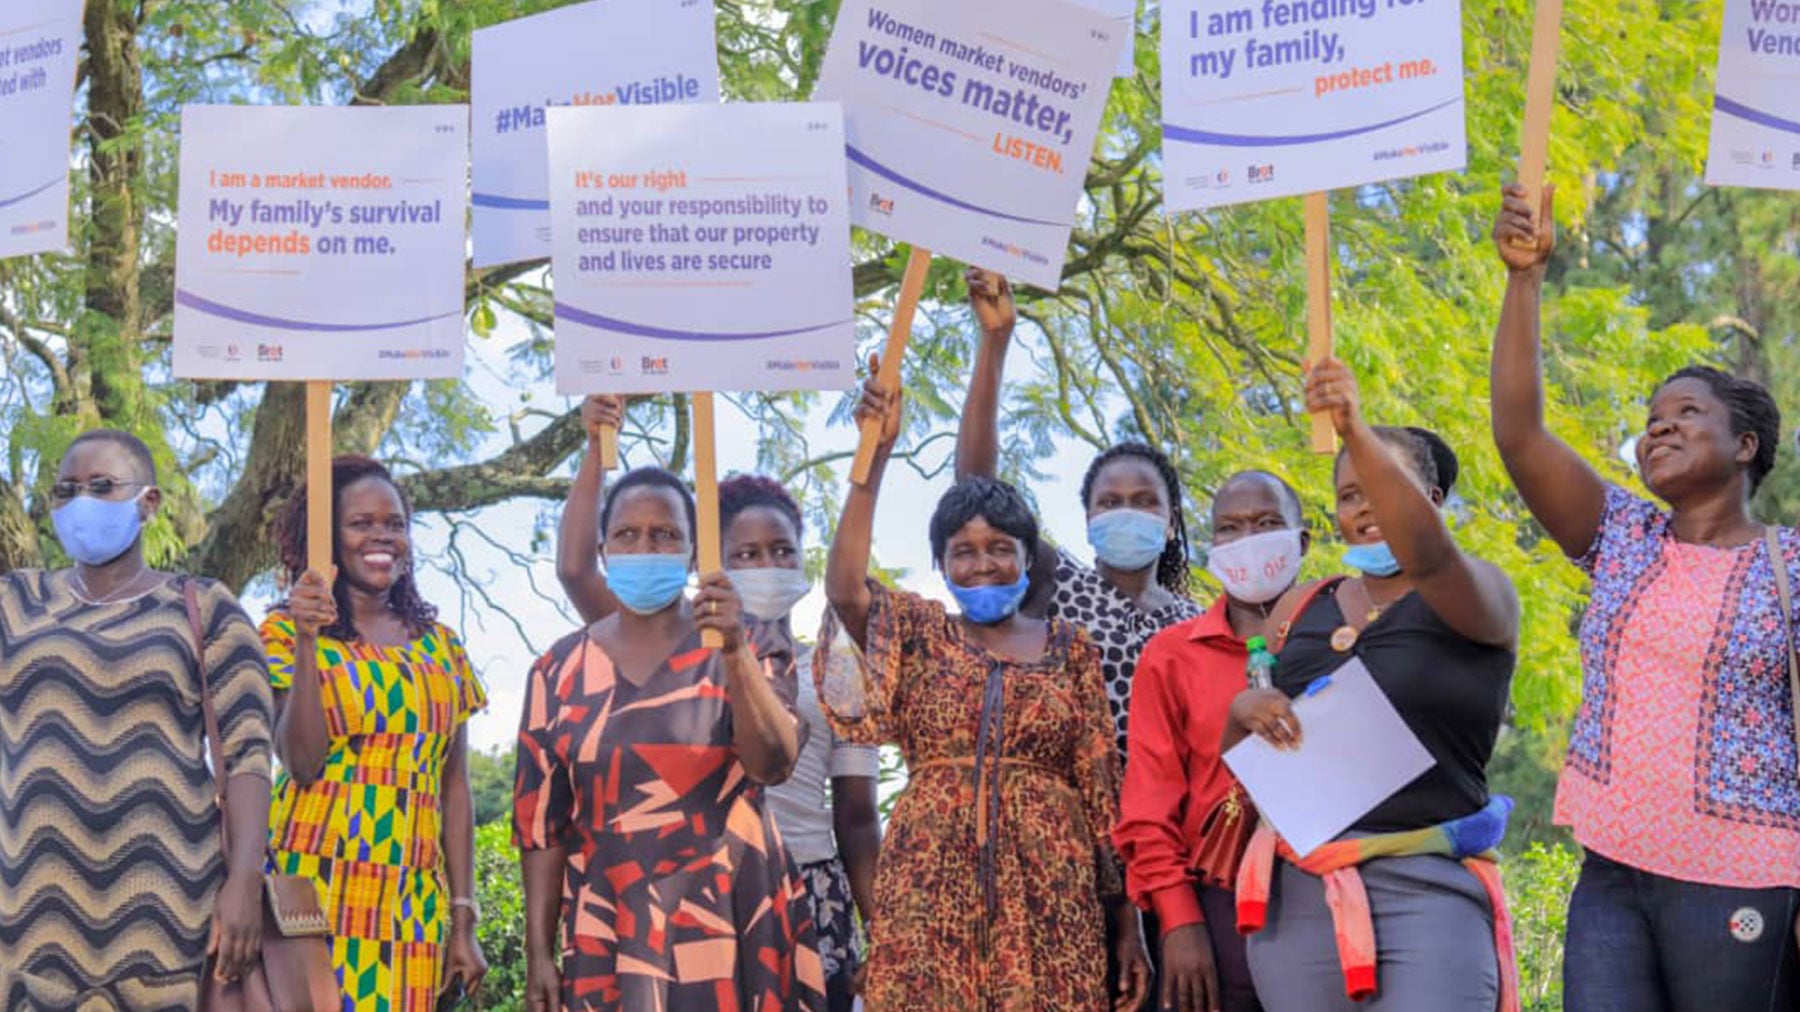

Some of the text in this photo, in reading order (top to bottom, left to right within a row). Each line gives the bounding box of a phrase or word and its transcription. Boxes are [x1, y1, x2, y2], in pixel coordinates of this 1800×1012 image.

[1190, 0, 1376, 38] I am fending
[13, 37, 62, 65] vendors
[867, 7, 936, 49] Women
[939, 37, 1005, 74] market
[1190, 29, 1345, 79] my family,
[20, 66, 46, 92] with
[1314, 57, 1438, 98] protect me.
[496, 73, 700, 133] #MaHerVisible
[858, 40, 1074, 145] voices matter,
[992, 132, 1065, 174] LISTEN.
[209, 170, 393, 189] I am a market vendor.
[607, 173, 639, 189] our
[642, 170, 688, 193] right
[208, 199, 441, 228] My family's survival
[576, 194, 829, 220] and your responsibility to
[207, 229, 397, 257] depends on me.
[577, 222, 820, 246] ensure that our property
[578, 250, 773, 272] and lives are secure
